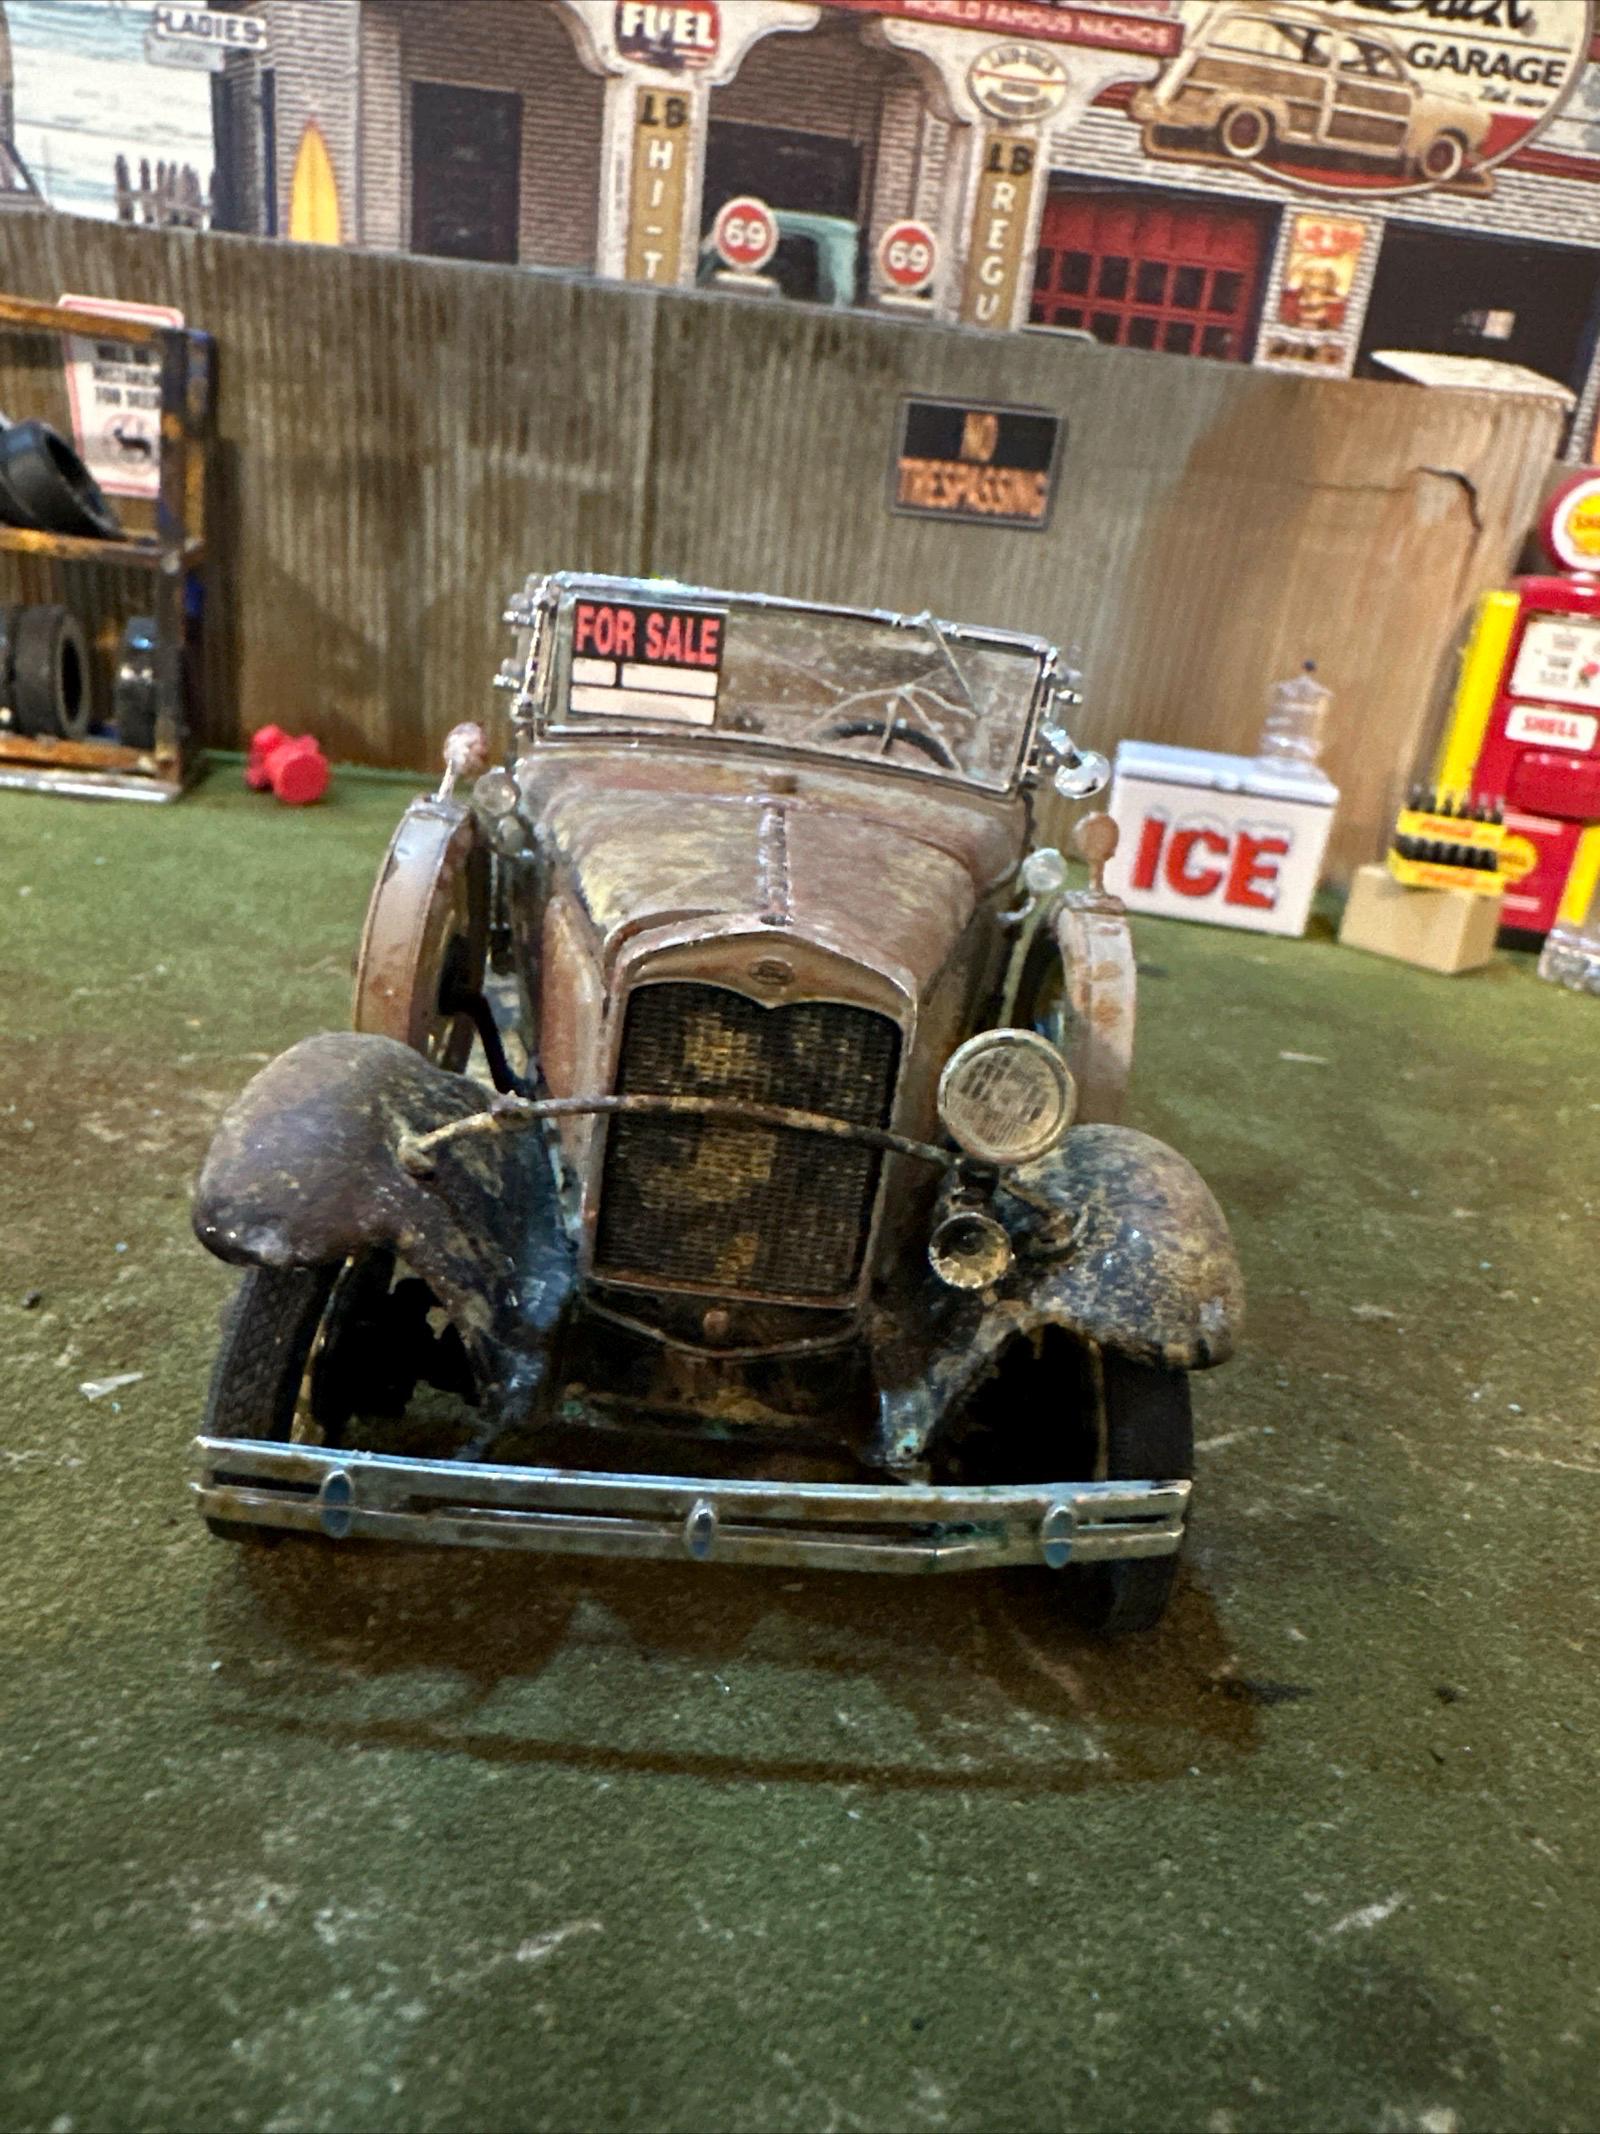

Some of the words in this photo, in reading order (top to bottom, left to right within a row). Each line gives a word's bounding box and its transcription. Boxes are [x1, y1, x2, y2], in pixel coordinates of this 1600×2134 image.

[164, 10, 261, 44] LADIES
[621, 2, 716, 46] FUEL
[1406, 41, 1567, 88] GARAGE
[888, 239, 929, 273] 69
[575, 604, 636, 657] FOR
[645, 612, 720, 665] SALE
[1522, 714, 1579, 738] SHELL
[1130, 815, 1290, 910] ICE
